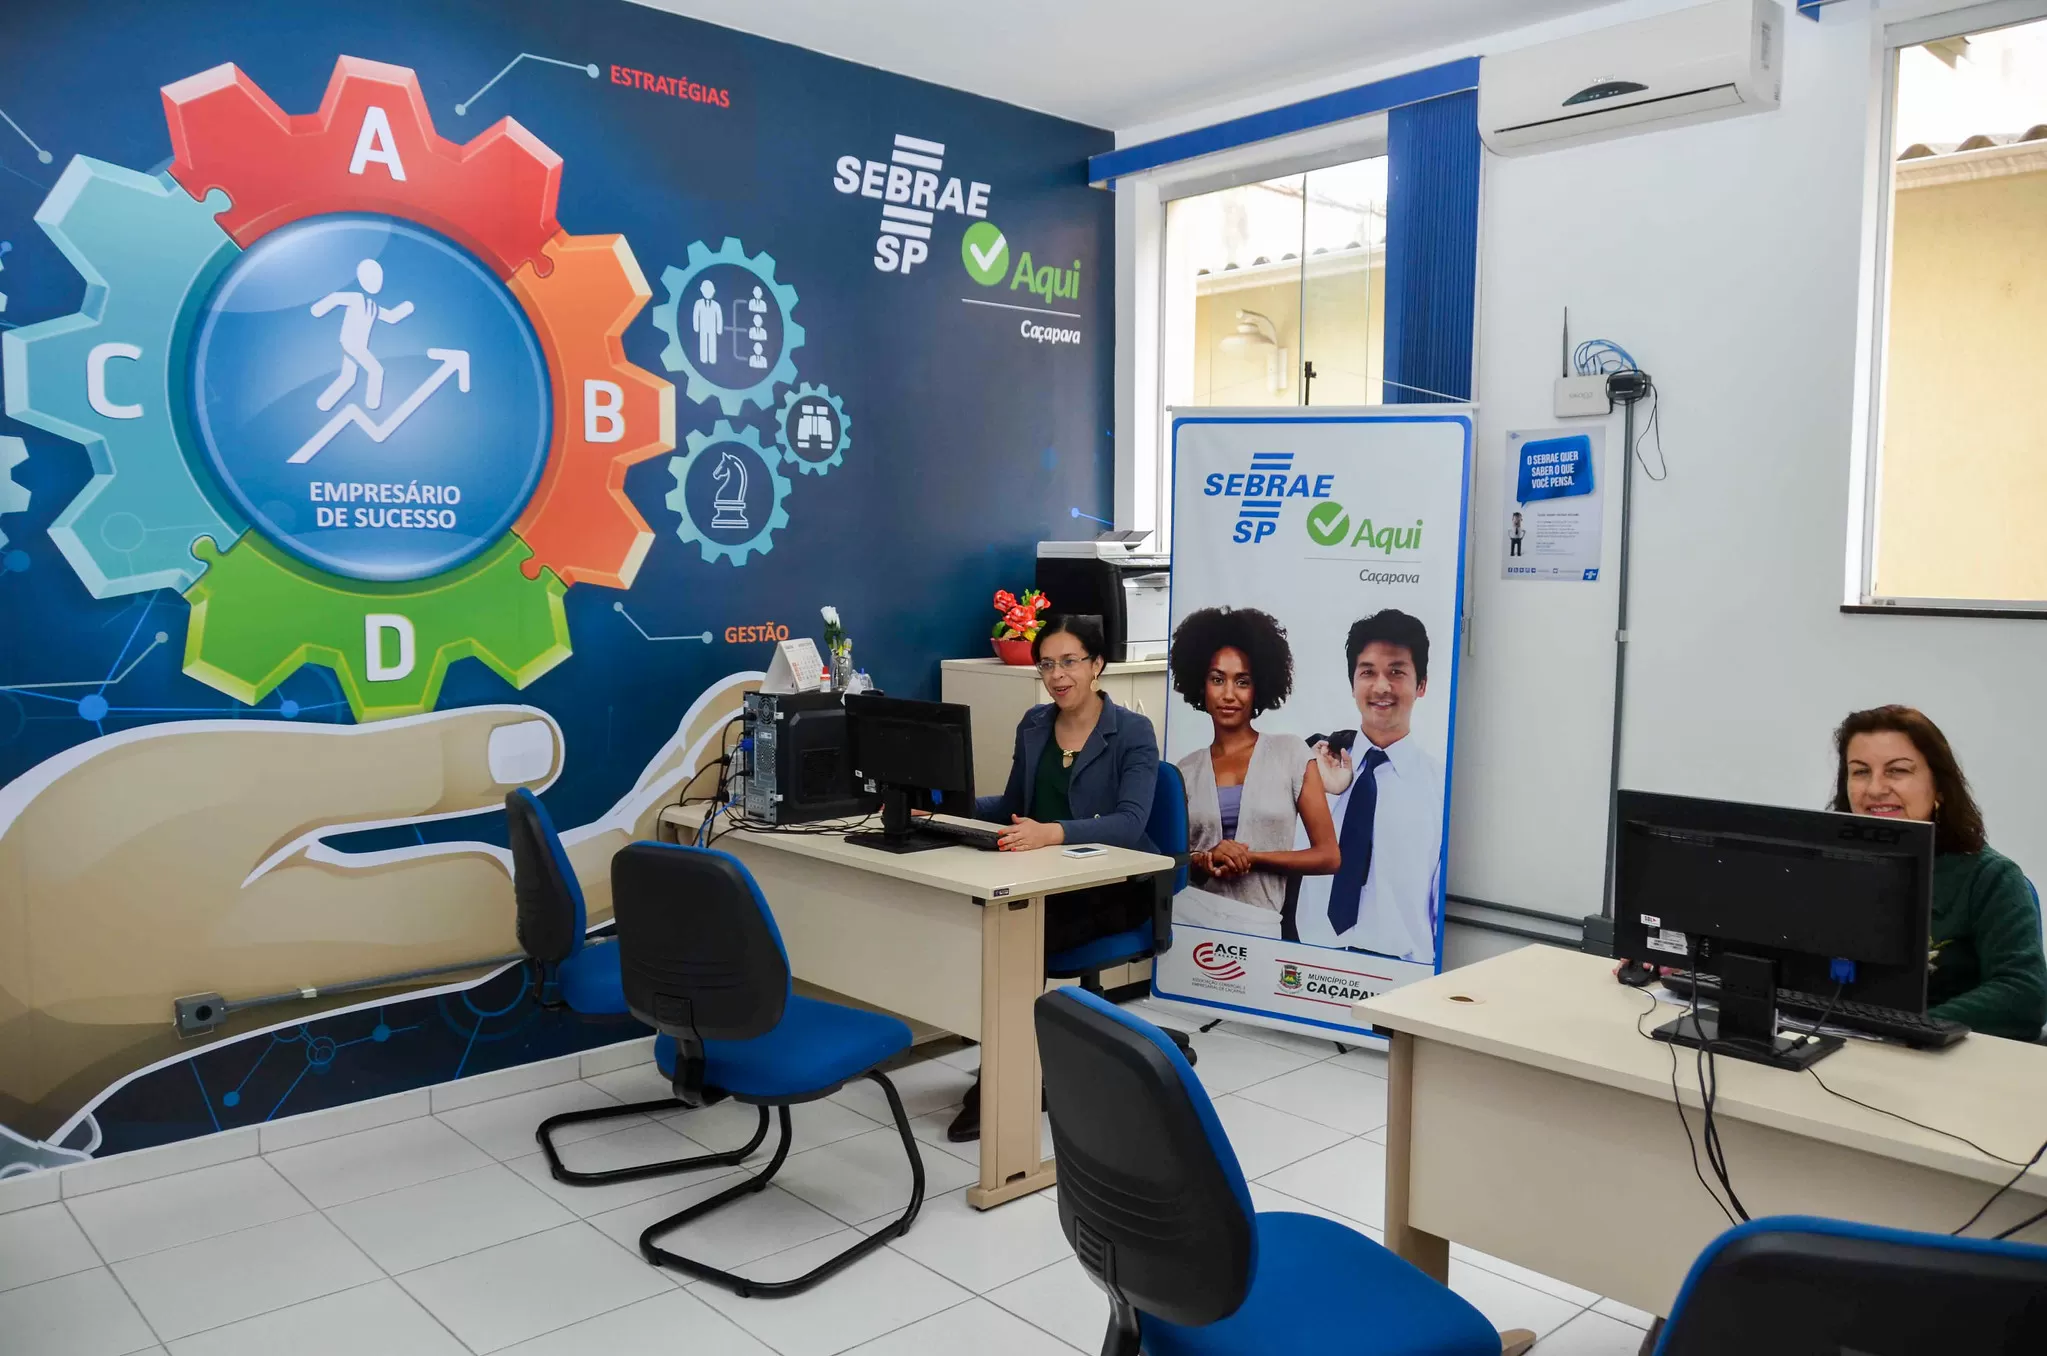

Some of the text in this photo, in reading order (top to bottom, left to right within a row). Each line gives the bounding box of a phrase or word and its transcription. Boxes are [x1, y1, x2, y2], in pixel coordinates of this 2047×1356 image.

[610, 64, 730, 108] ESTRATÉGIAS
[348, 107, 407, 182] A
[833, 155, 991, 218] SEBRAE
[874, 235, 928, 274] SP
[1010, 252, 1081, 304] Aqui
[1020, 320, 1081, 344] Caçapava
[86, 342, 145, 420] C
[583, 379, 626, 444] B
[1527, 450, 1579, 465] O SEBRAE QUER
[1531, 463, 1575, 477] SABER O QUE
[1532, 475, 1575, 488] VOCÊ PENSA.
[310, 480, 461, 505] EMPRESÁRIO
[1203, 473, 1335, 498] SEBRAE
[316, 507, 456, 529] DE SUCESSO
[1232, 520, 1276, 544] SP
[1350, 518, 1423, 555] Aqui
[1359, 569, 1420, 585] Caçapava
[725, 622, 790, 643] GESTÃO
[364, 613, 416, 682] D
[1214, 943, 1247, 957] ACE
[1306, 981, 1381, 1001] CAÇAPA
[1307, 973, 1348, 985] MUNICÍPIO
